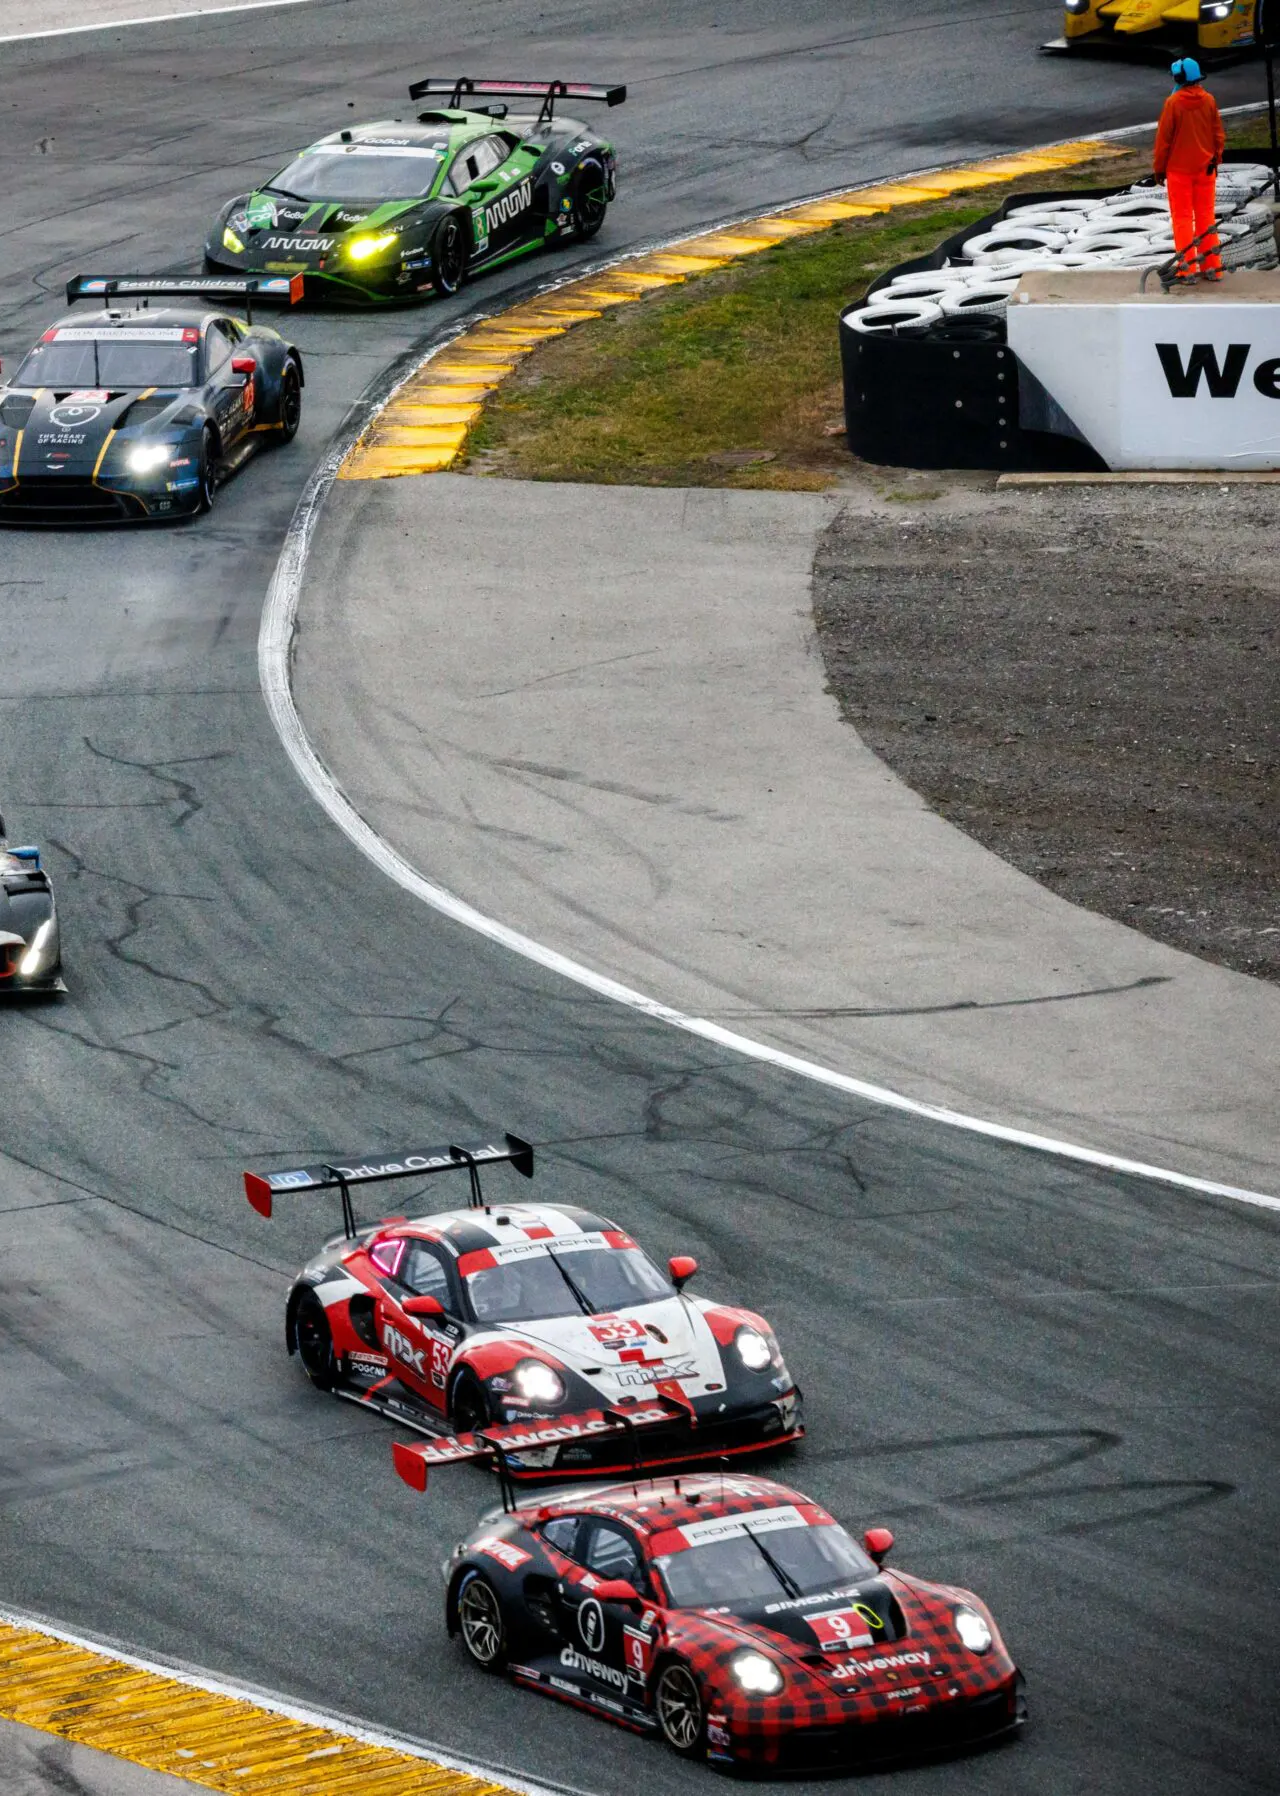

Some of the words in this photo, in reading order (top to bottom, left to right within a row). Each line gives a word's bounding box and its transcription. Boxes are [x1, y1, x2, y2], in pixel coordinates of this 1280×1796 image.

[262, 237, 336, 251] ARROW
[119, 279, 176, 288] Seattle
[340, 1163, 400, 1179] Drive
[498, 1237, 603, 1257] PORSCHE
[598, 1321, 637, 1340] 53
[432, 1341, 451, 1374] 53
[692, 1515, 798, 1539] PORSCHE
[764, 1588, 861, 1614] SIMONIZ
[827, 1615, 852, 1639] 9
[632, 1639, 644, 1669] 9
[831, 1651, 931, 1679] driveway
[560, 1642, 629, 1695] driveway
